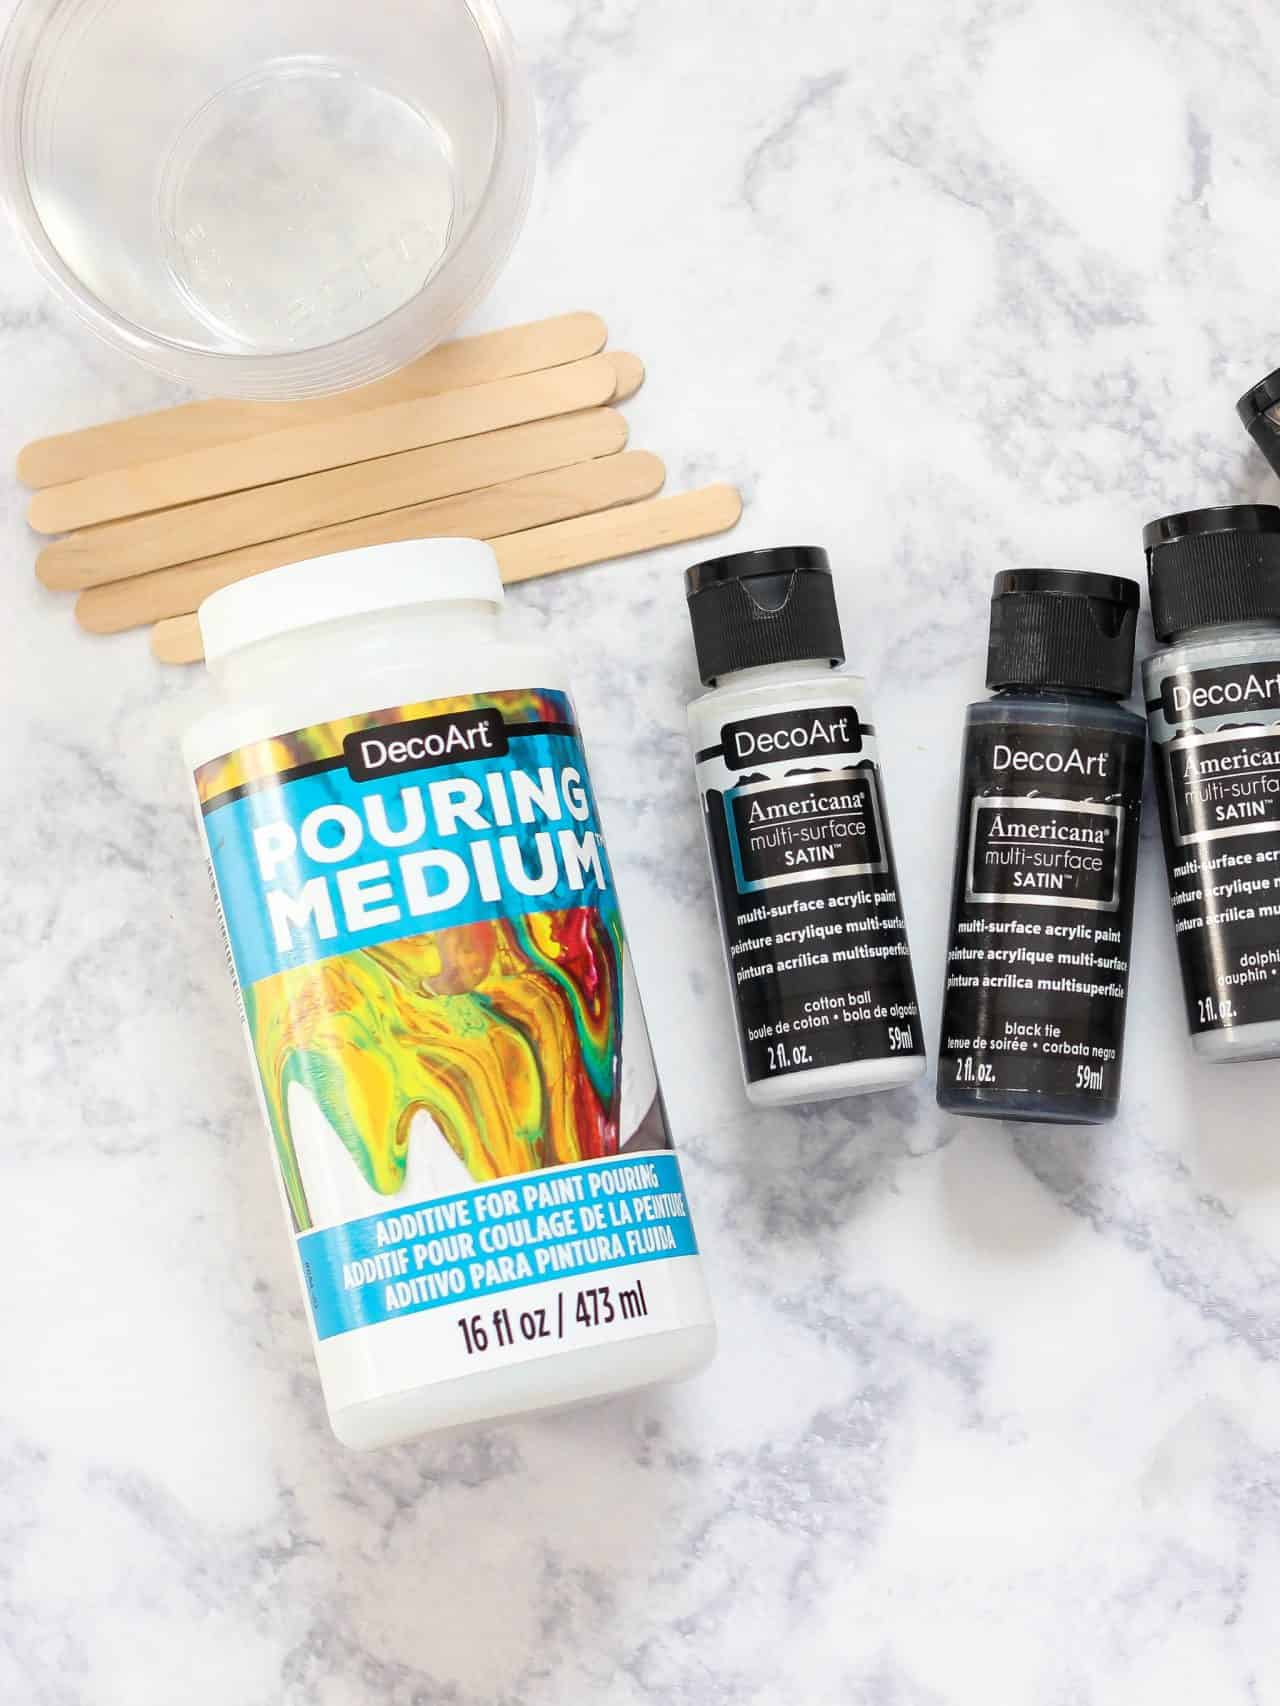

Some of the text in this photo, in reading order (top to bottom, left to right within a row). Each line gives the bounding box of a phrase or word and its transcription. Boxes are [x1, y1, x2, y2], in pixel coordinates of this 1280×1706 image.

[253, 767, 587, 880] POURING
[751, 820, 866, 851] multi-surface
[985, 848, 1102, 871] multi-surface
[1173, 854, 1252, 878] multi-surface
[1205, 871, 1269, 898] acrylique
[737, 890, 896, 926] multi-surface acrylic paint
[1206, 908, 1255, 927] acrílica
[775, 920, 843, 945] acrylique
[846, 916, 905, 933] multi-surfac
[958, 919, 1120, 943] multi-surface acrylic paint
[737, 964, 774, 984] pintura
[777, 952, 829, 972] acrílica
[987, 948, 1054, 964] acrylique
[982, 975, 1033, 989] acrílica
[1217, 968, 1267, 985] dauphin
[804, 991, 871, 1012] cotton ball
[1198, 1000, 1205, 1023] 2
[748, 1024, 773, 1040] boule
[775, 1020, 789, 1033] de
[793, 1013, 829, 1030] coton
[843, 1006, 871, 1022] bola
[874, 1004, 888, 1017] de
[1005, 1022, 1061, 1038] black tie
[889, 1026, 913, 1050] 59ml
[973, 1037, 987, 1049] de
[990, 1037, 1028, 1050] soirée
[1043, 1042, 1089, 1056] corbata
[1092, 1048, 1115, 1061] negra
[768, 1047, 776, 1069] 2
[956, 1058, 962, 1081] 2
[1076, 1065, 1103, 1090] 59ml
[377, 1164, 658, 1247] ADDITIVE FOR PAINT POURING
[343, 1252, 409, 1289] ADDITIF
[414, 1235, 475, 1267] POUR
[479, 1209, 576, 1253] COULAGE
[581, 1204, 604, 1228] DE
[609, 1199, 632, 1224] LA
[385, 1226, 677, 1311] ADITIVO PARA PINTURA FLUIDA
[458, 1315, 488, 1354] 16
[492, 1308, 514, 1346] fl
[520, 1308, 550, 1340] oz
[576, 1287, 614, 1327] 473
[619, 1279, 648, 1320] ml
